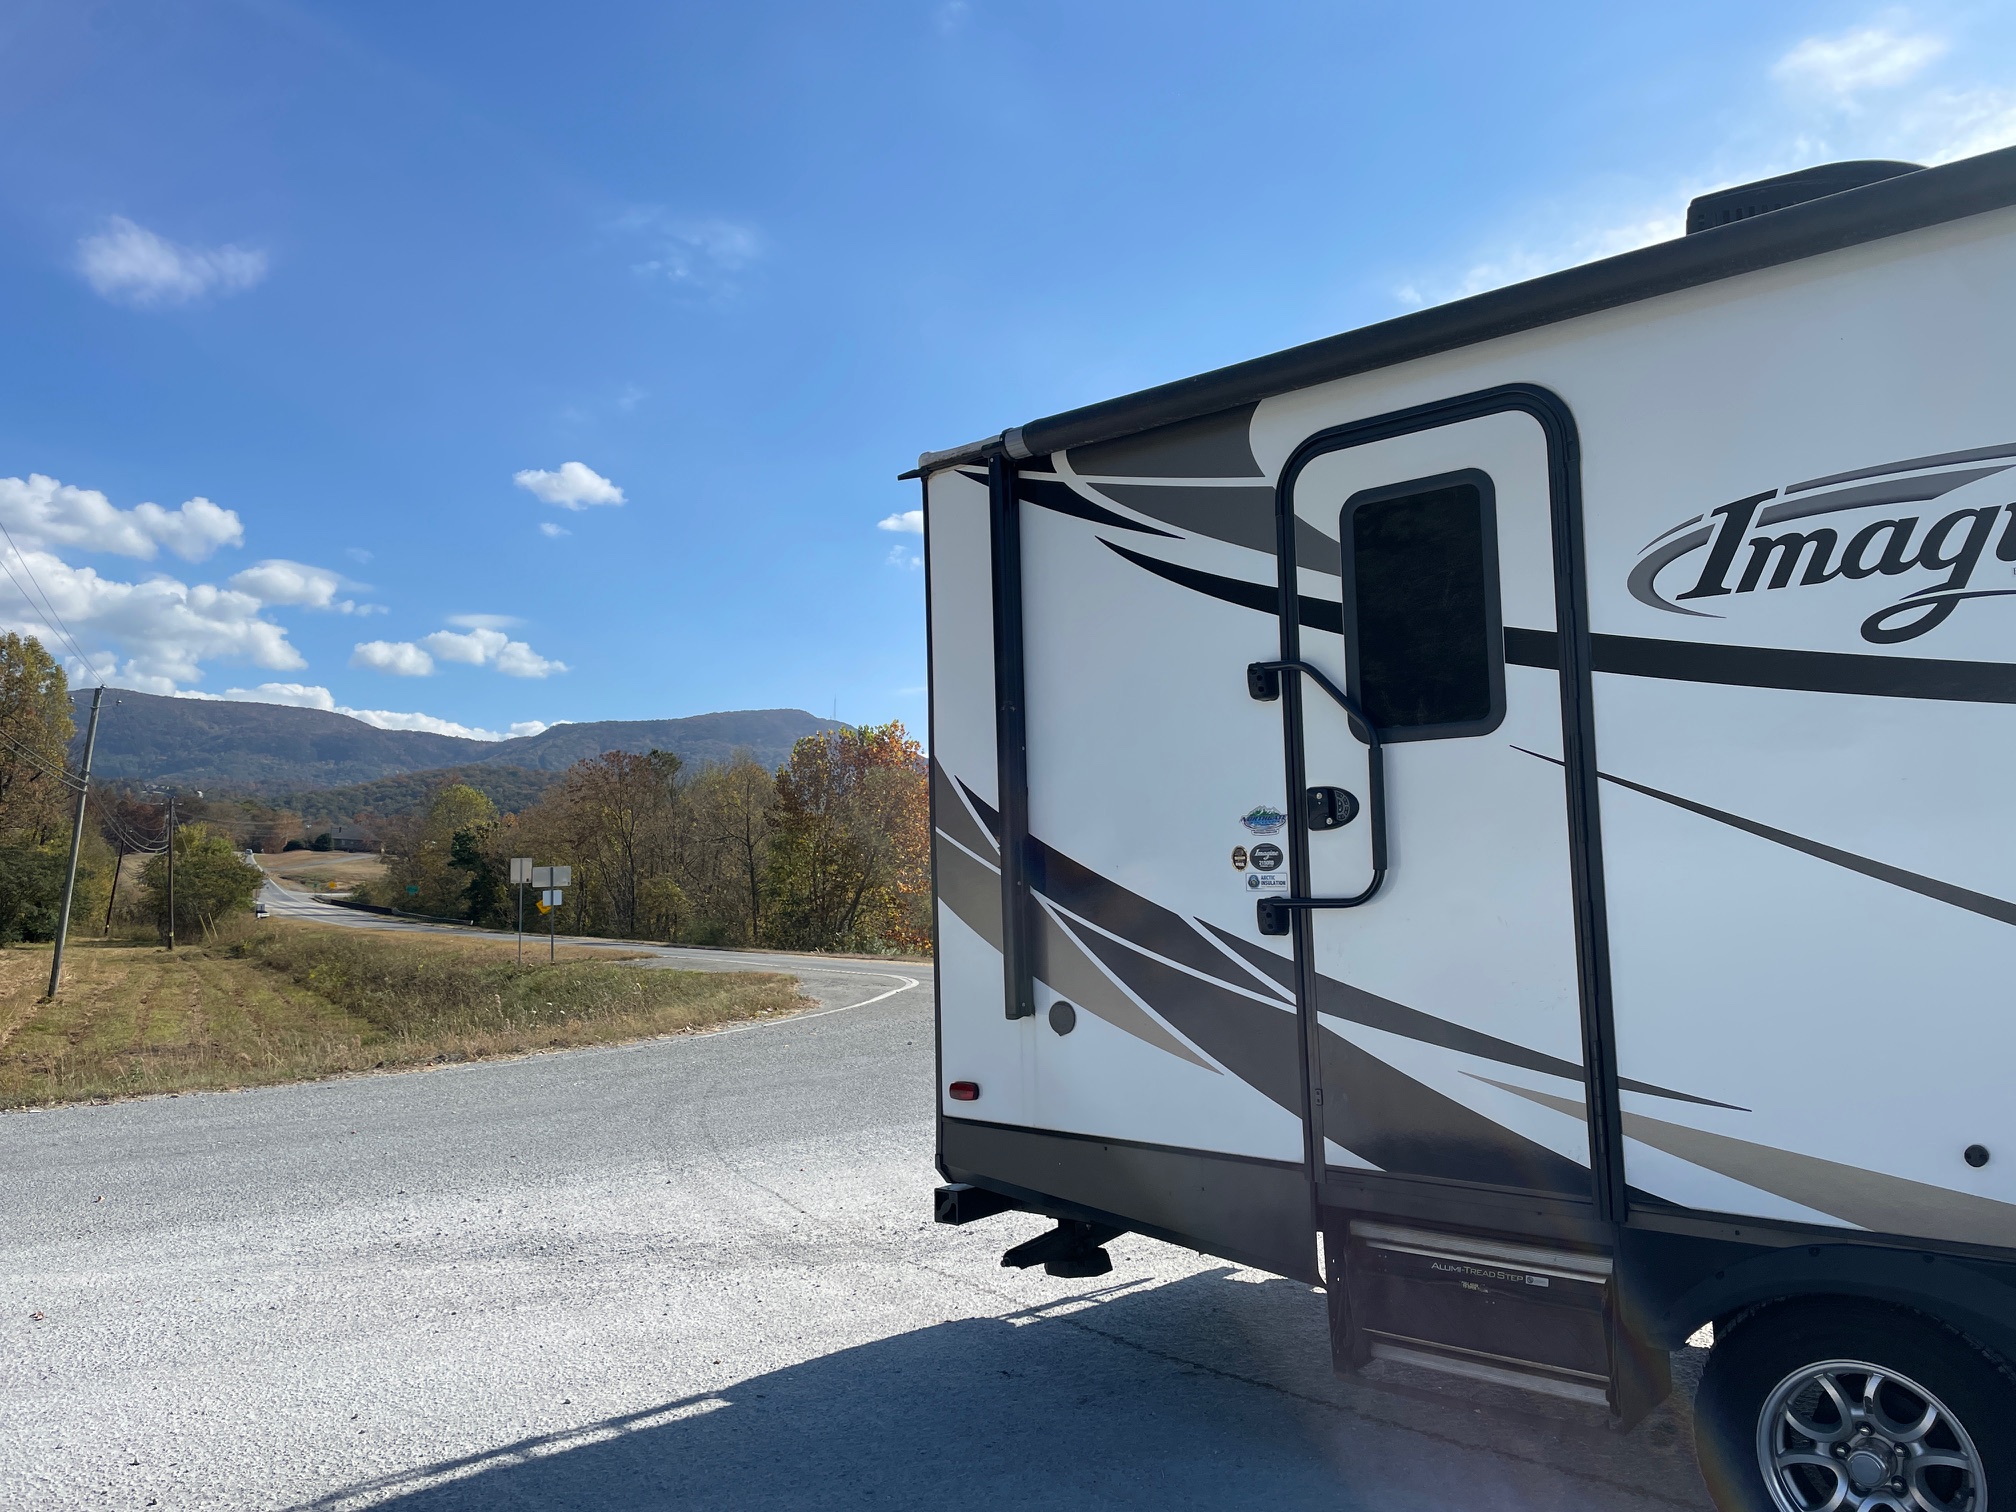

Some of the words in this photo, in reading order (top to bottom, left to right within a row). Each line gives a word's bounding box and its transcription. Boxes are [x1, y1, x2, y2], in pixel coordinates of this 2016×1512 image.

[1254, 849, 1279, 860] Imagine
[1431, 1262, 1496, 1278] ALUMI-TREAD
[1497, 1271, 1524, 1282] STEP
